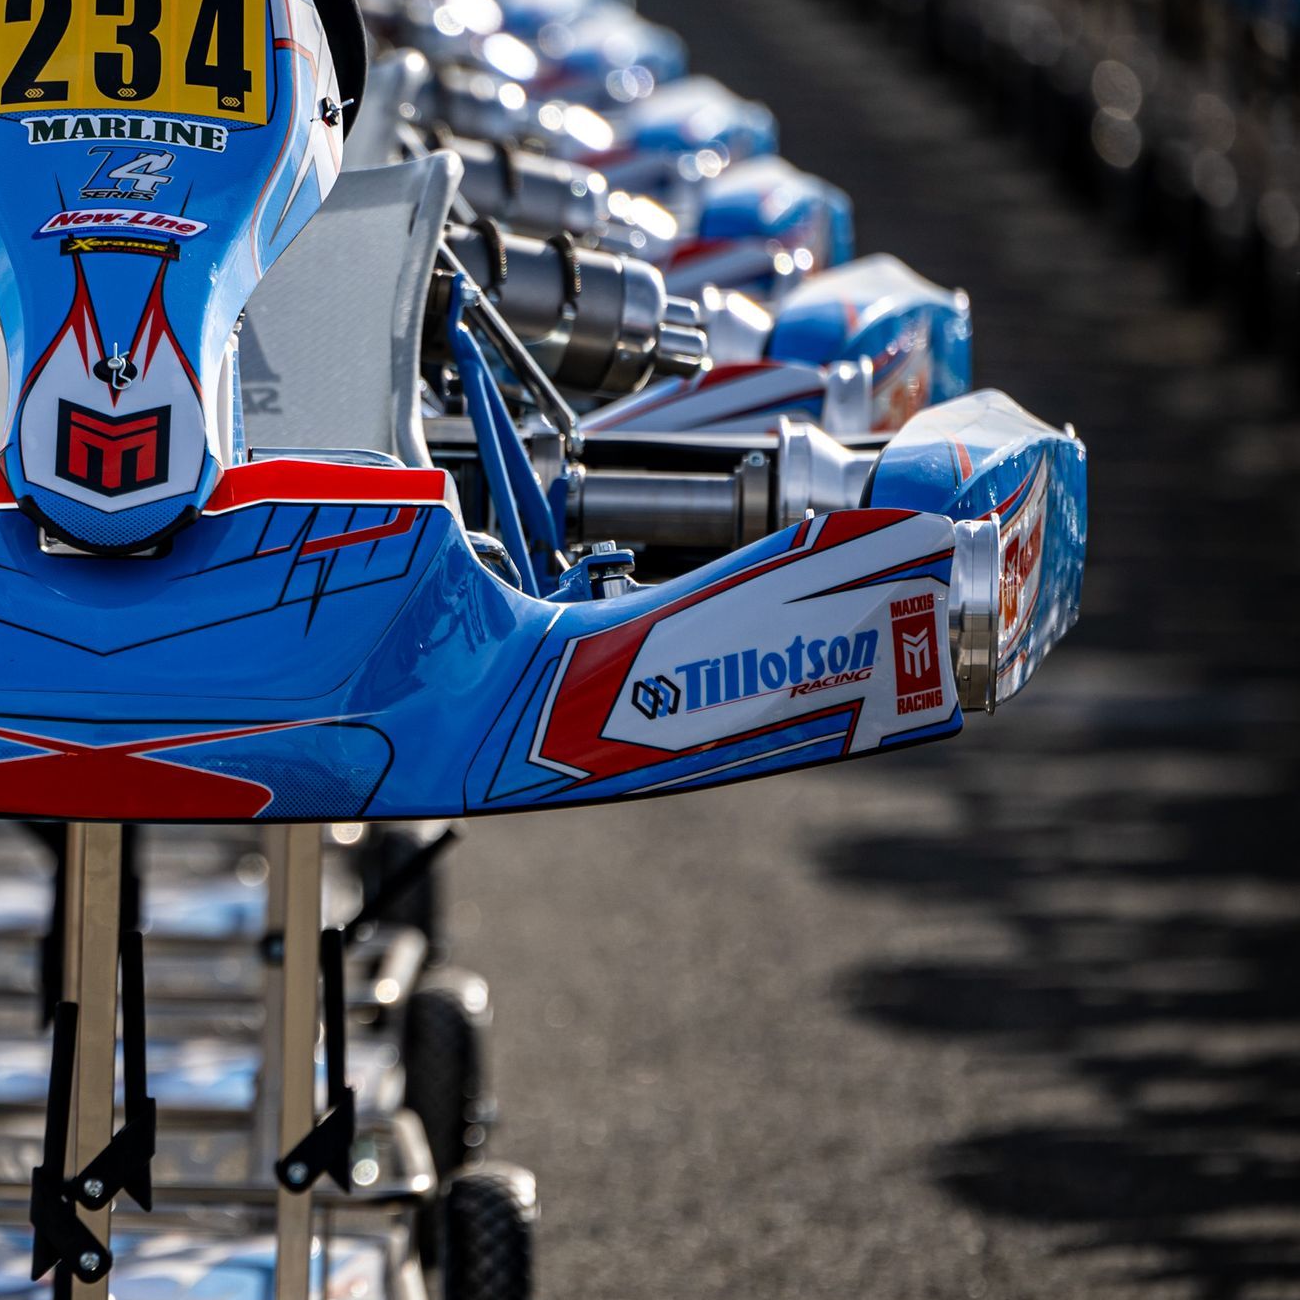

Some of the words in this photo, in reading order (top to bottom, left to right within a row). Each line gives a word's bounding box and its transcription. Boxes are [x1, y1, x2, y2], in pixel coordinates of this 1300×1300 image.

[26, 117, 224, 150] MARLINE
[80, 191, 155, 200] SERIES
[50, 212, 197, 232] New-Line
[890, 593, 934, 618] MAXXIS
[676, 629, 878, 712] Tillotson
[789, 667, 873, 698] RACING
[897, 689, 943, 715] RACING
